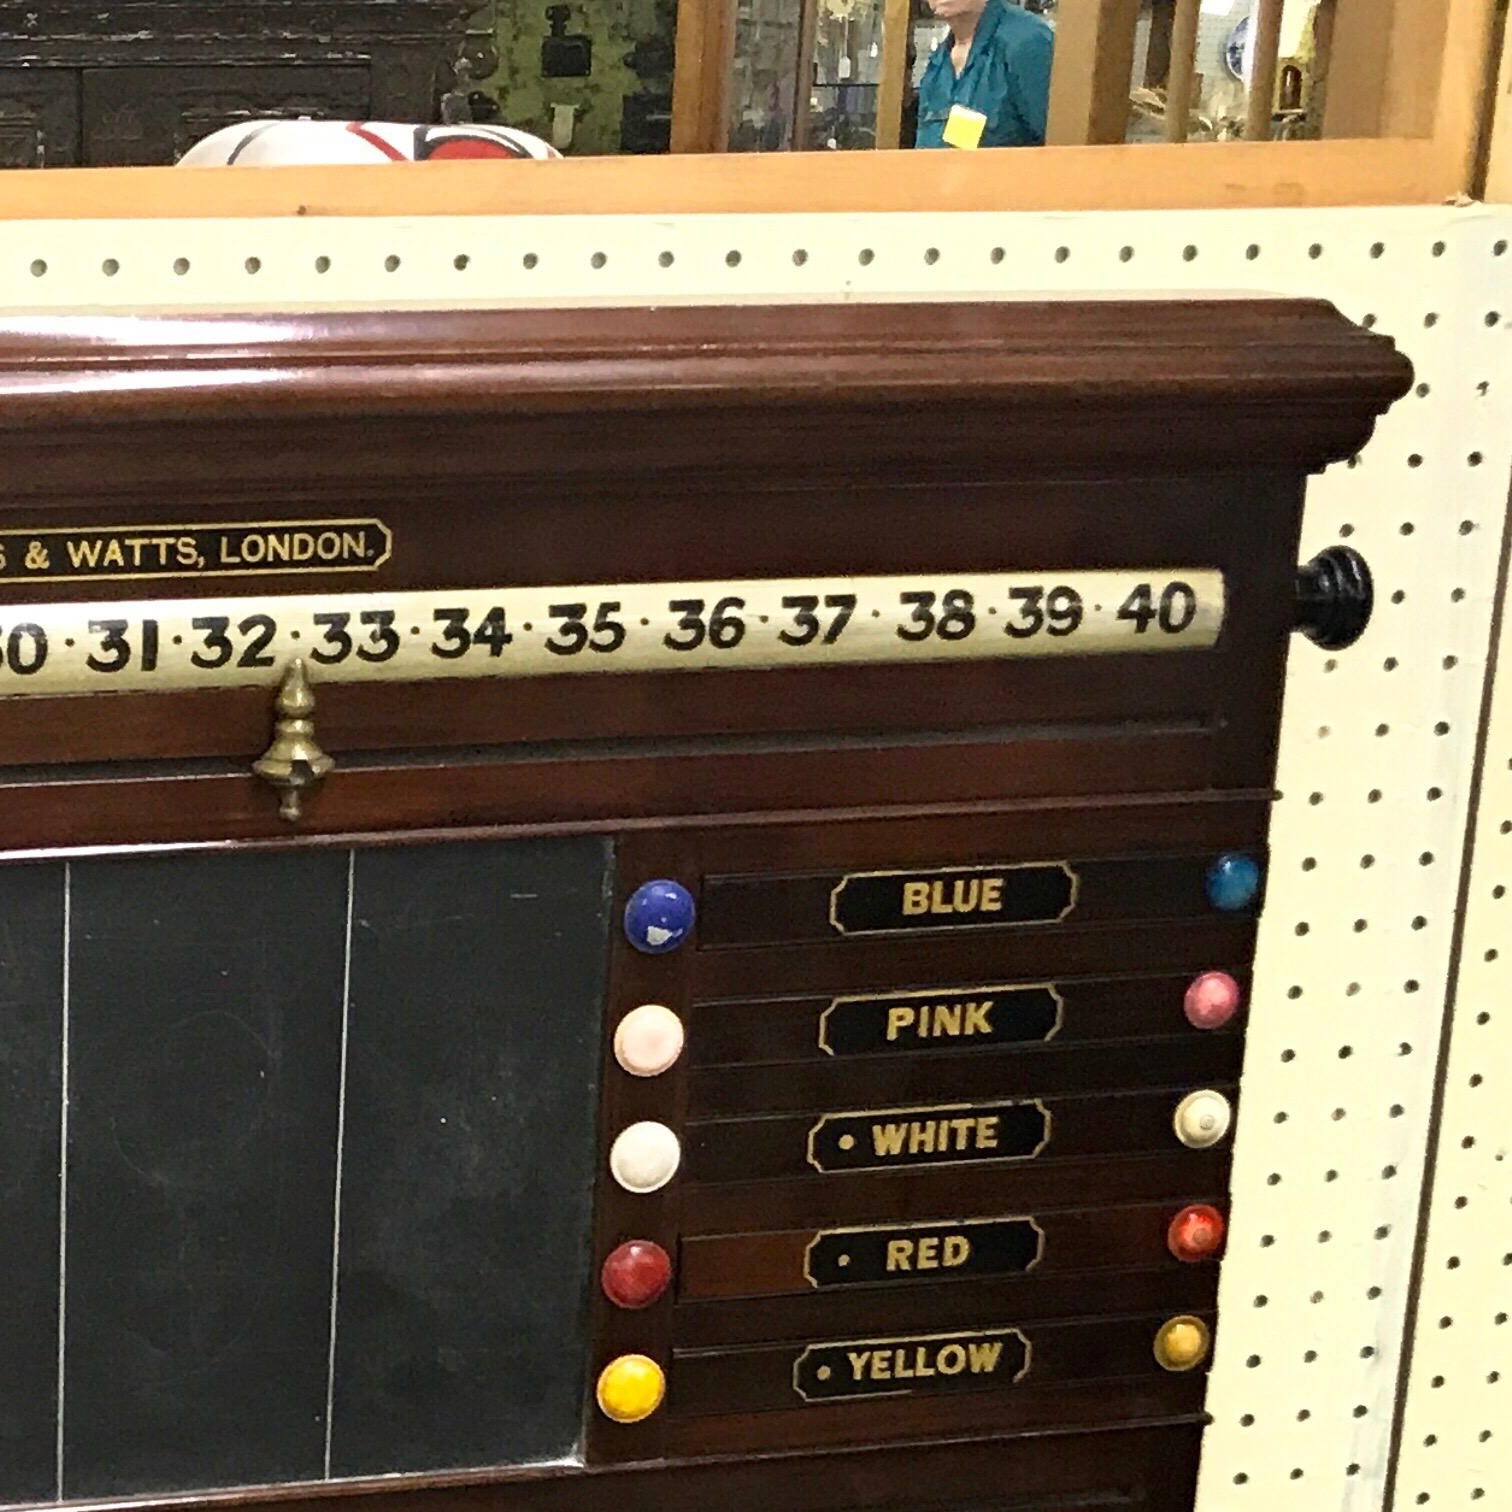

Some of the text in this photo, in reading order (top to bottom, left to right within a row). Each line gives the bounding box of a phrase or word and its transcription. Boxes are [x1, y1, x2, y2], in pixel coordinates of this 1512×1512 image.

[25, 542, 50, 569] &
[67, 538, 205, 567] WATTS,
[221, 531, 374, 564] LONDON.
[86, 619, 158, 672] 31
[191, 614, 276, 668] 32
[311, 610, 401, 664] 33
[431, 606, 513, 659] 34
[545, 600, 627, 655] 35
[664, 596, 746, 650] 36
[779, 593, 858, 646] 37
[897, 589, 976, 642] 38
[1005, 585, 1083, 638] 39
[1116, 581, 1197, 634] 40
[902, 878, 1004, 915] BLUE
[887, 1002, 994, 1041] PINK
[872, 1116, 999, 1156] WHITE
[886, 1236, 971, 1271] RED
[847, 1342, 1003, 1380] YELLOW
